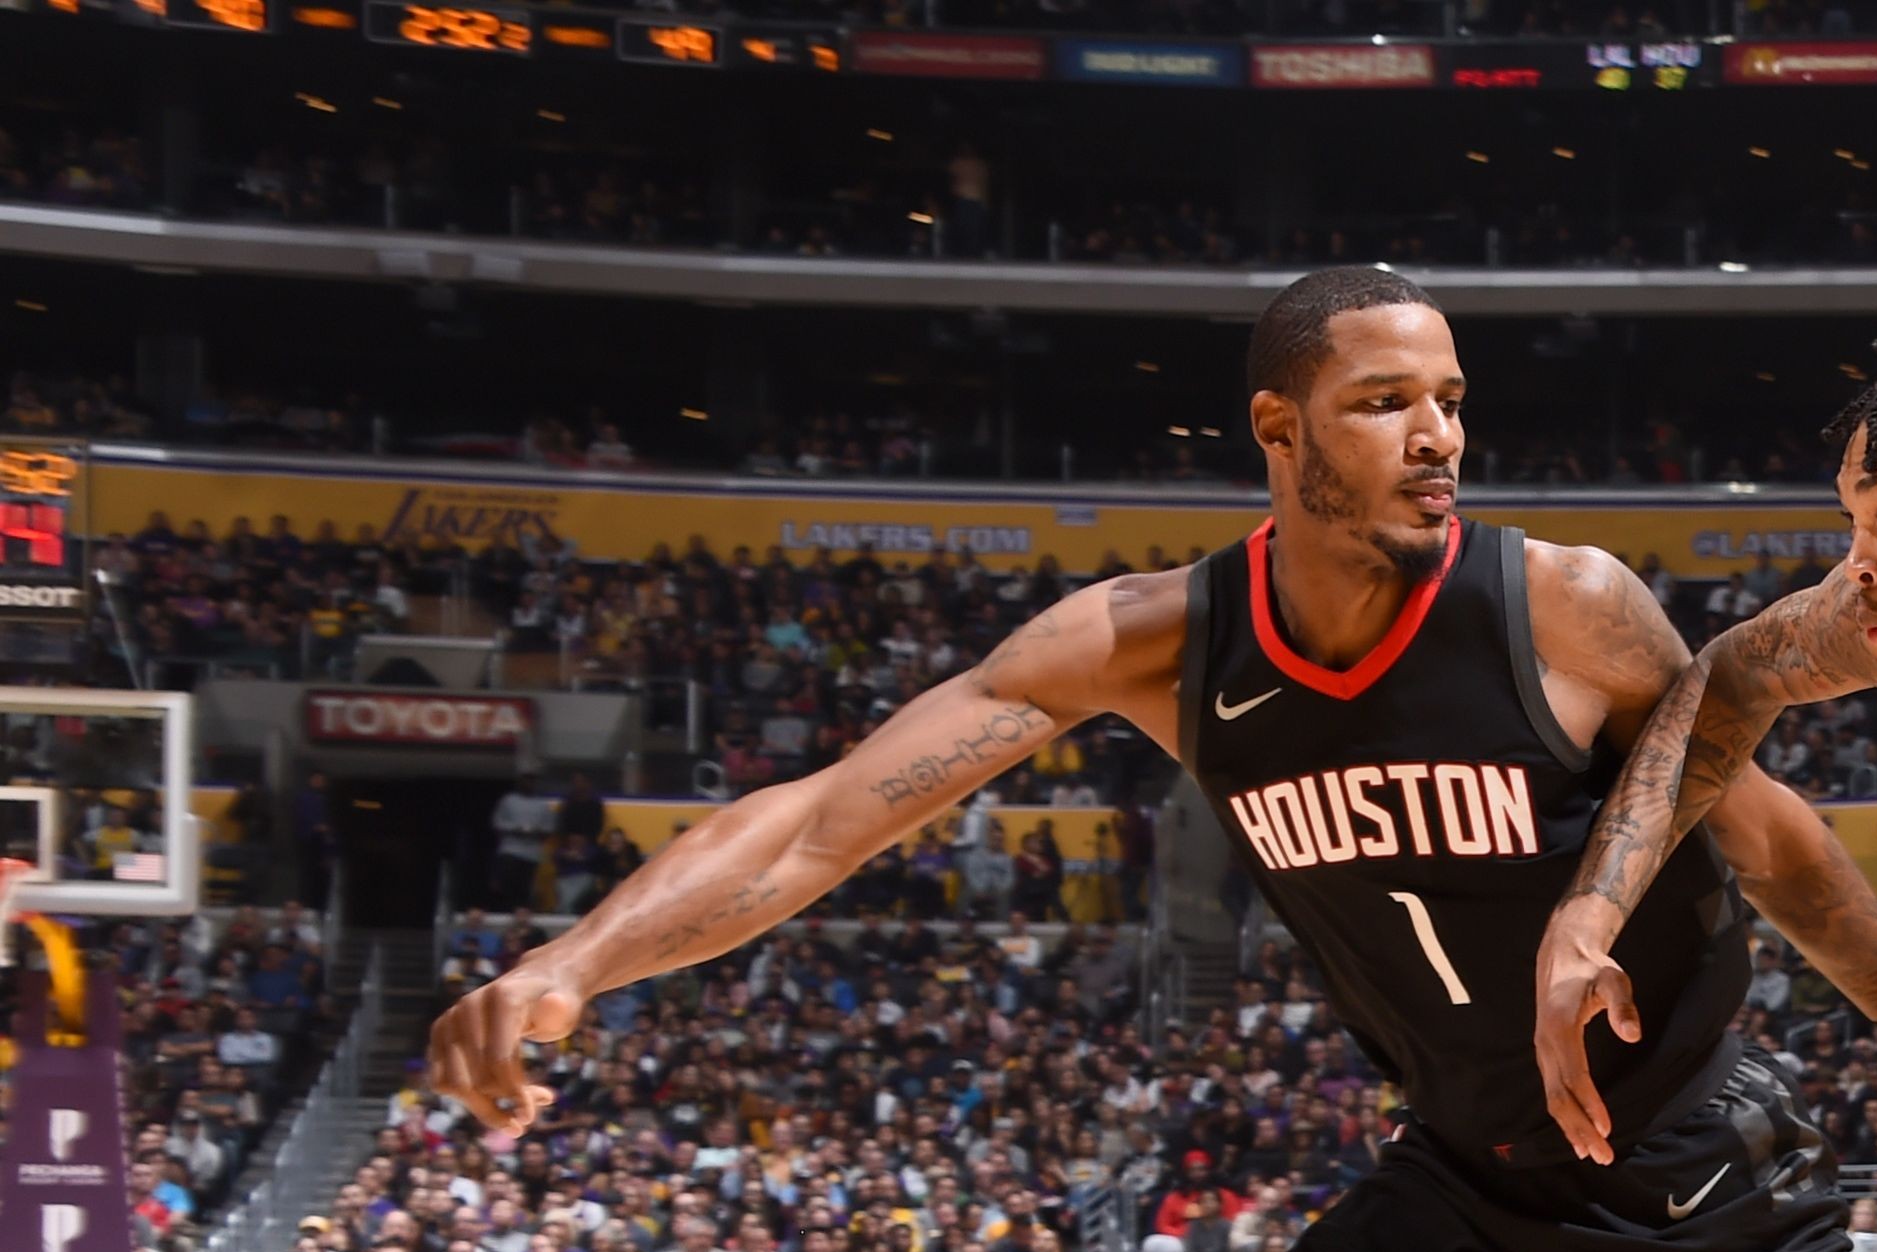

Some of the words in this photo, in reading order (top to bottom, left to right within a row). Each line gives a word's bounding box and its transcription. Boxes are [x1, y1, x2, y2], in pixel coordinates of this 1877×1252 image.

[1256, 47, 1431, 86] TOSHIBA
[313, 698, 528, 736] TOYOTA
[1229, 761, 1542, 871] HOUSTON
[1388, 891, 1472, 1006] 1
